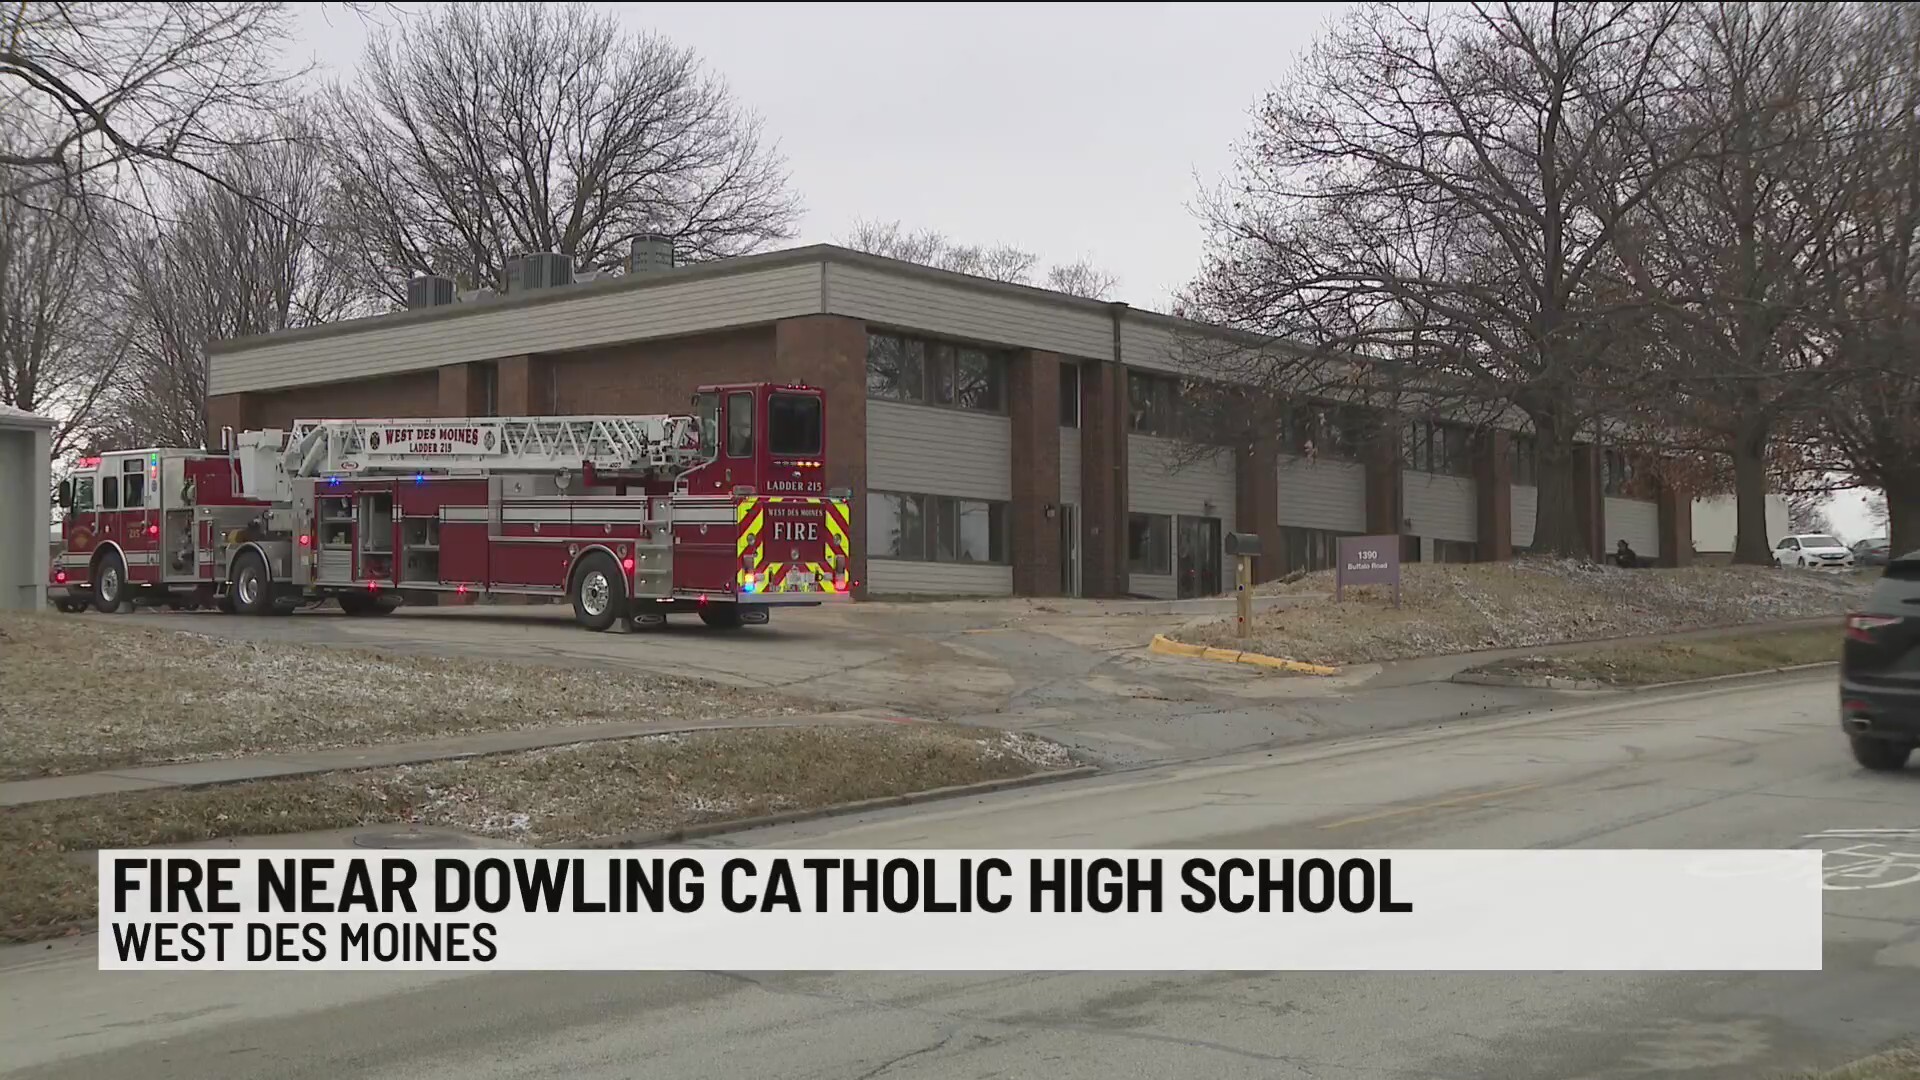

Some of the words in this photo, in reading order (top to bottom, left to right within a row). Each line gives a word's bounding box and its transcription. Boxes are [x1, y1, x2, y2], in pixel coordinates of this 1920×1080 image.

[385, 428, 414, 445] WEST
[416, 428, 436, 440] DES
[439, 428, 479, 446] MOINES
[409, 442, 438, 453] LADDER
[766, 480, 804, 491] LADDER
[807, 481, 822, 492] 215
[768, 507, 785, 517] WEST
[787, 508, 799, 517] DES
[800, 508, 824, 517] MOINES
[774, 521, 818, 540] FIRE
[1358, 550, 1378, 560] 1390
[1347, 562, 1371, 570] Buffalo
[1371, 561, 1388, 569] Road
